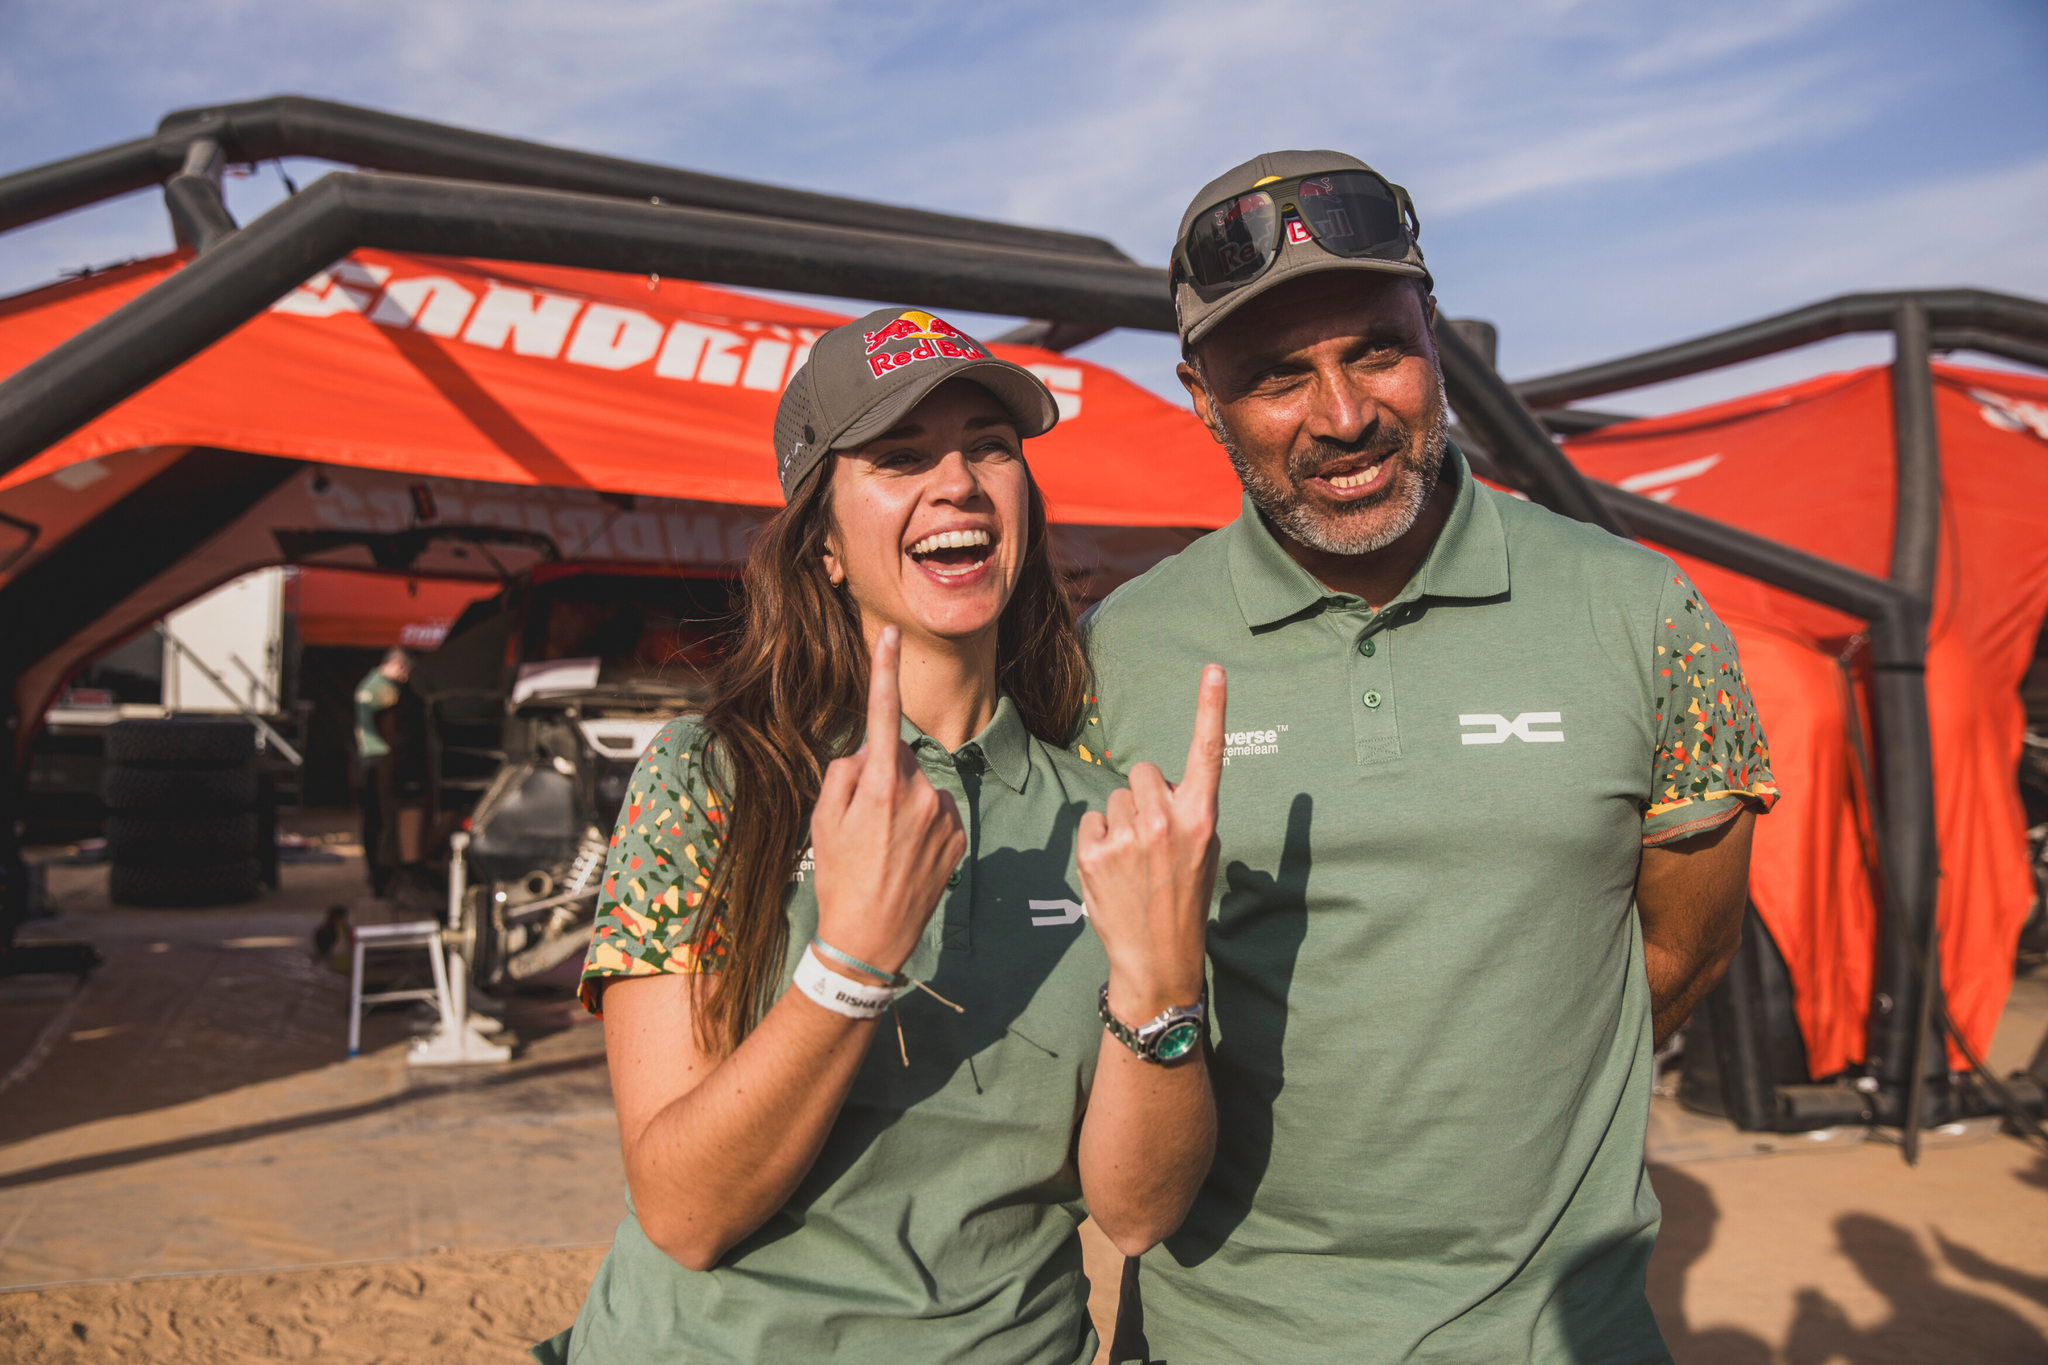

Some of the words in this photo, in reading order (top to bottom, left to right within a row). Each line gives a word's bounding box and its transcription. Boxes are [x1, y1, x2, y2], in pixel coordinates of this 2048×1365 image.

[866, 338, 938, 379] Red
[1224, 729, 1277, 746] verse
[1223, 743, 1279, 757] remeTeam
